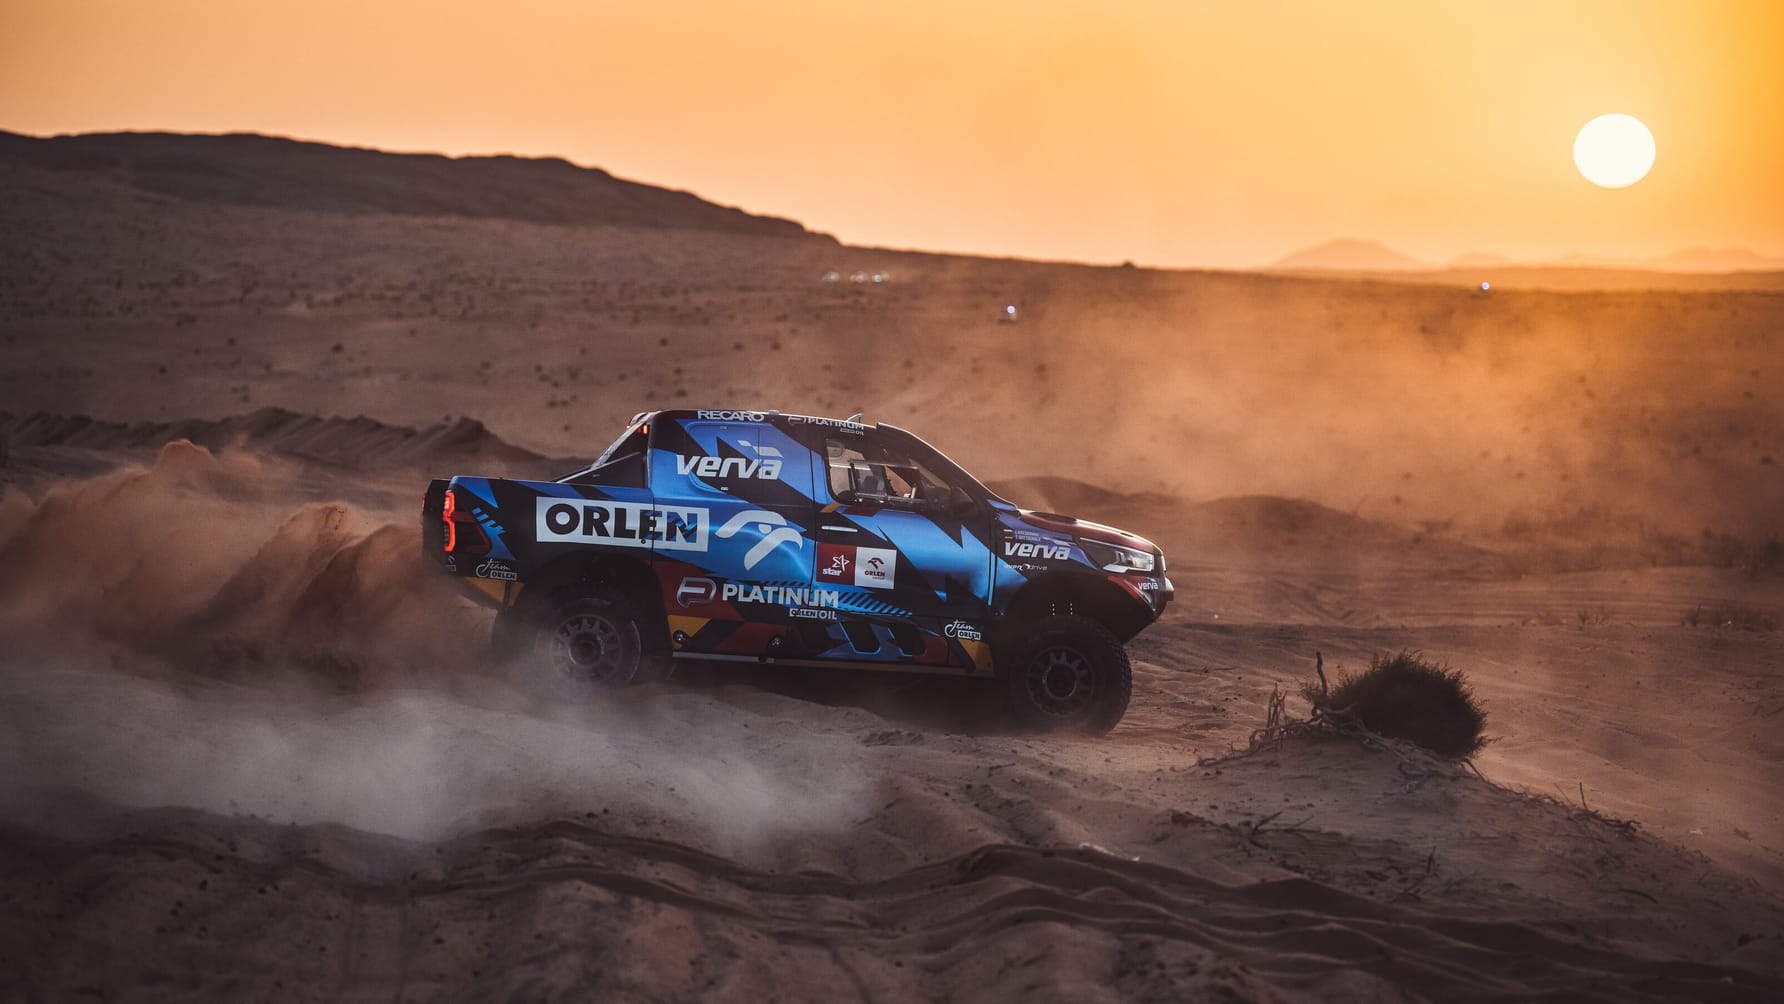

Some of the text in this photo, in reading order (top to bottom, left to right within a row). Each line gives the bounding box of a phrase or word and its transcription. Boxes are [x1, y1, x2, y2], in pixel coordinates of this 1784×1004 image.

[697, 410, 765, 422] RECARO
[807, 416, 865, 430] PLATINUM
[676, 454, 783, 480] verva
[545, 503, 698, 544] ORLEN
[1004, 541, 1071, 561] verva
[822, 567, 842, 577] star
[1137, 582, 1159, 590] verva
[722, 583, 839, 609] PLATINUM
[791, 609, 838, 620] ORLEN OIL
[958, 630, 981, 640] ORLEN
